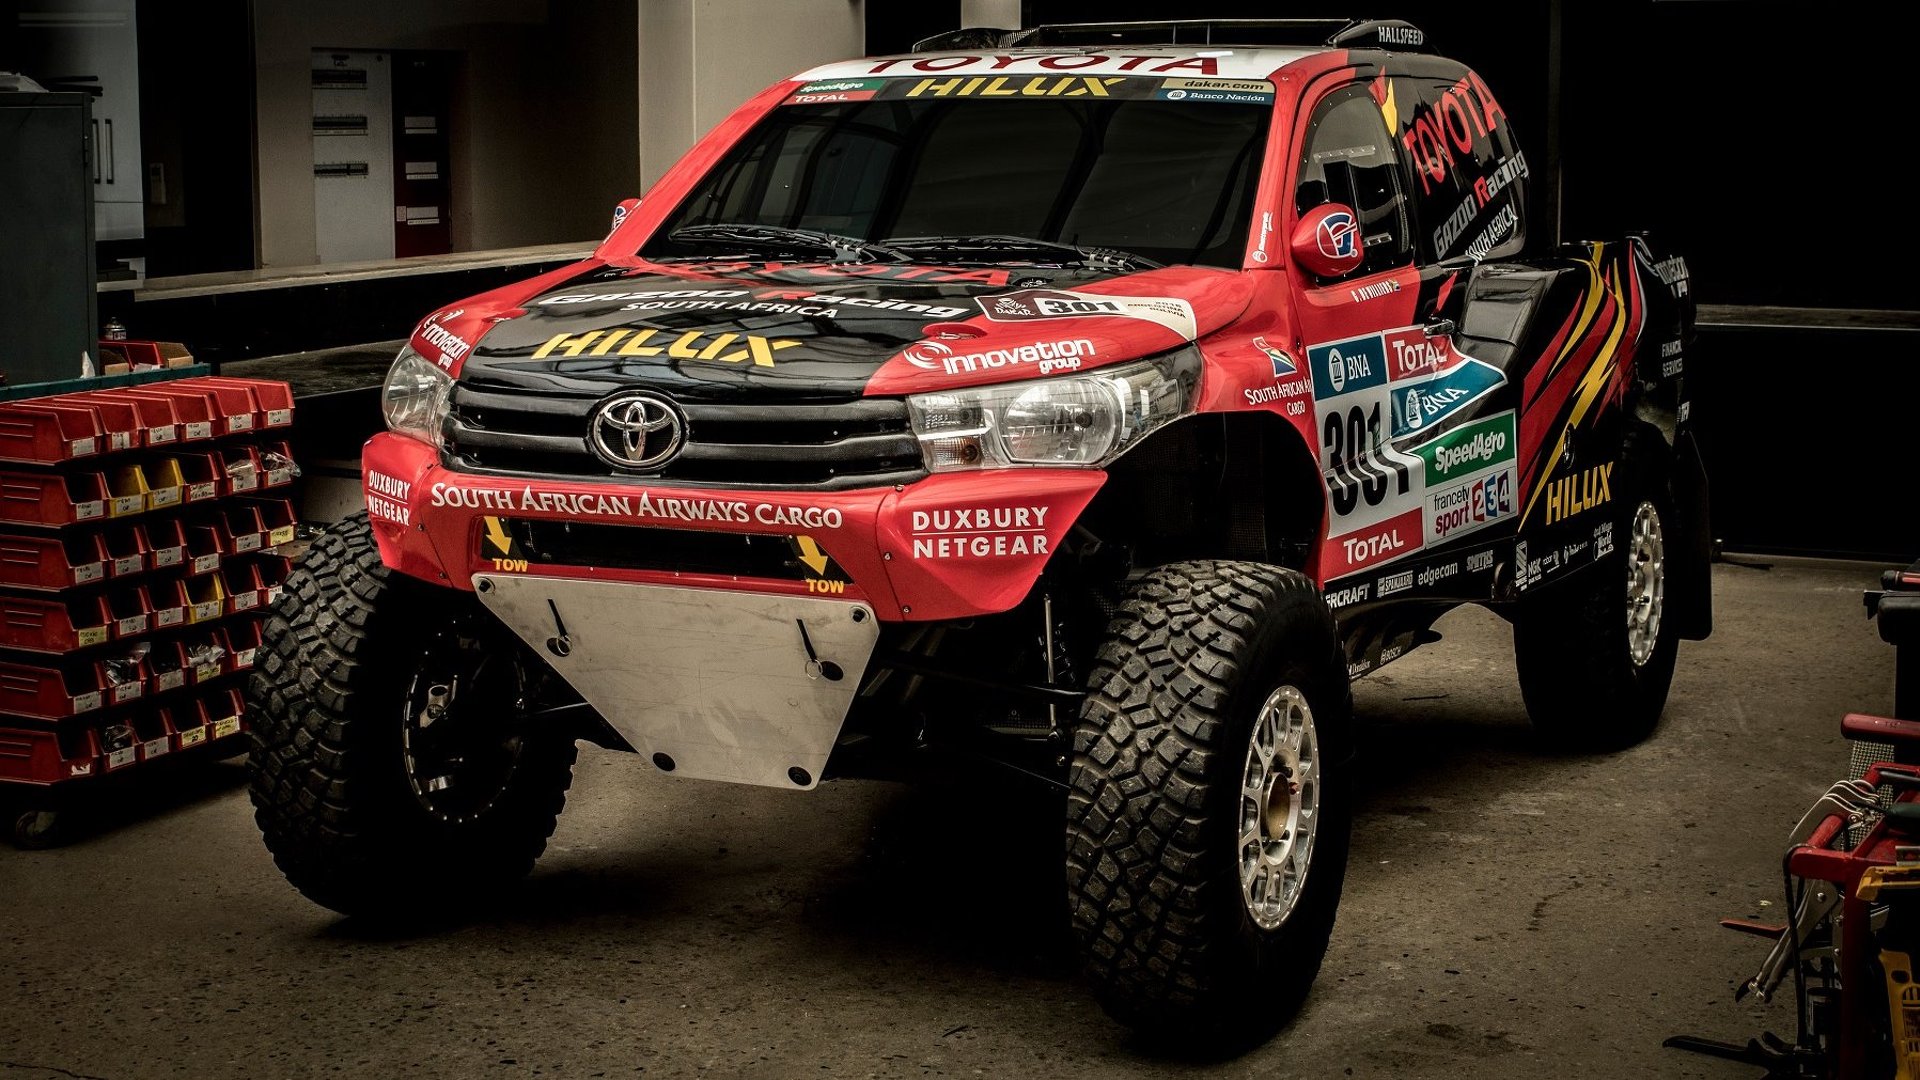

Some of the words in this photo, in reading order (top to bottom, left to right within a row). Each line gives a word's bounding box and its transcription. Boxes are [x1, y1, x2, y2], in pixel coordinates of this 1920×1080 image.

[1377, 26, 1424, 46] HALLSPEED
[868, 54, 1218, 76] TOYOTA
[795, 93, 848, 103] TOTAL
[905, 77, 1128, 97] HILUX
[1184, 79, 1265, 91] dakar.com
[1189, 91, 1224, 101] Banco
[1226, 92, 1265, 102] Nación
[1402, 69, 1507, 196] TOYOTA
[1433, 194, 1478, 261] GAZOO
[1473, 150, 1530, 209] Racing
[1465, 228, 1491, 267] SOUTH
[1486, 203, 1519, 244] AFRICA
[538, 290, 750, 305] GAZOO
[752, 289, 971, 319] Racing
[620, 300, 728, 312] SOUTH
[730, 301, 839, 319] AFRICA
[994, 306, 1037, 317] DAKAR
[1043, 299, 1121, 314] 301
[530, 328, 804, 368] HILUX
[941, 338, 1097, 375] innovation
[1391, 338, 1447, 373] TOTAL
[1038, 356, 1082, 375] group
[1347, 353, 1372, 380] BNA
[1244, 385, 1279, 406] SOUTH
[1276, 379, 1304, 399] AFRICAN
[1421, 386, 1470, 416] BNA
[1323, 401, 1410, 517] 301
[1434, 430, 1506, 475] SpeedAgro
[368, 469, 411, 501] DUXBURY
[1433, 485, 1470, 512] francetv
[1545, 460, 1615, 527] HILUX
[367, 493, 410, 527] NETGEAR
[430, 482, 517, 511] SOUTH
[520, 485, 633, 516] AFRICAN
[636, 490, 751, 523] AIRWAYS
[754, 503, 843, 529] CARGO
[911, 506, 1049, 531] DUXBURY
[1435, 500, 1470, 537] sport
[912, 535, 1049, 560] NETGEAR
[1343, 529, 1405, 565] TOTAL
[491, 557, 529, 573] TOW
[1417, 561, 1459, 588] edgecam
[805, 578, 845, 594] TOW
